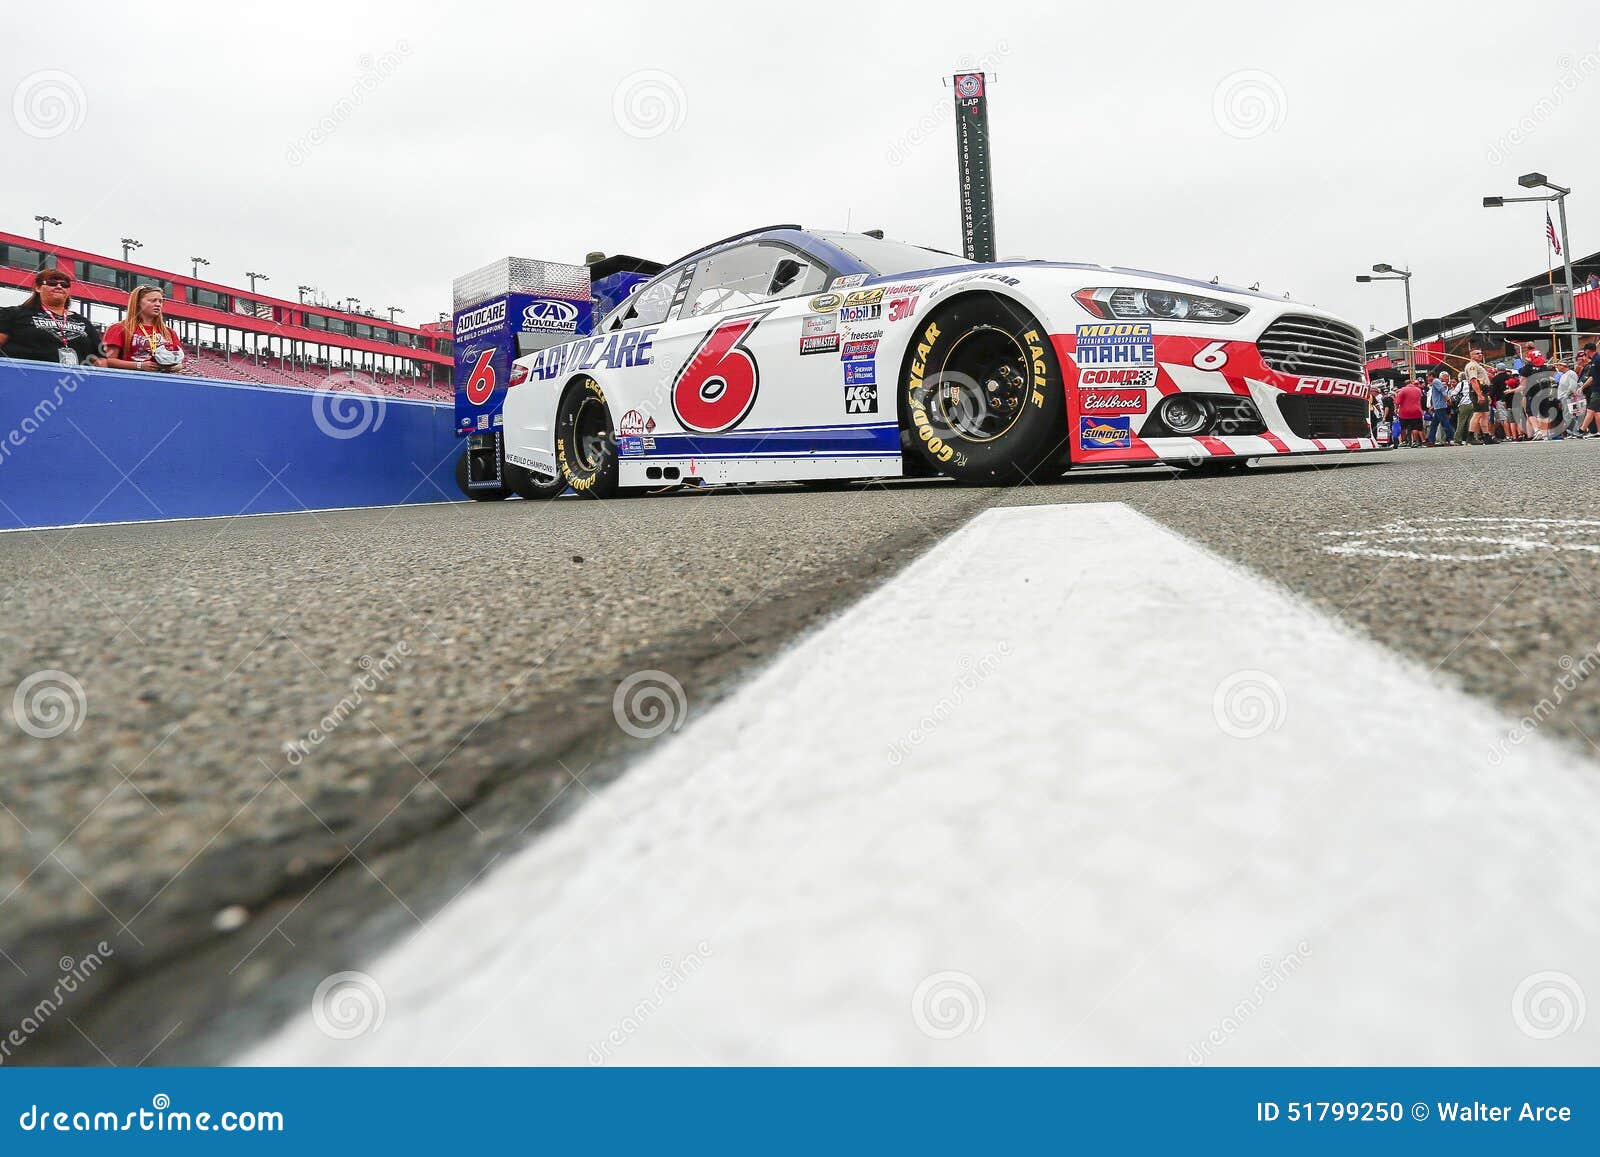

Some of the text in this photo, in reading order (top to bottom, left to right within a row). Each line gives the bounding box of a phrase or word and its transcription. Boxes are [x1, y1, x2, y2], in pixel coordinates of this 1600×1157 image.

[885, 284, 915, 296] Holley
[840, 306, 868, 320] Mobil
[889, 296, 919, 321] 3M
[457, 302, 506, 333] ADVOCARE
[522, 318, 577, 330] ADVOCARE
[851, 329, 883, 340] freescale
[1078, 324, 1149, 337] MOOG
[1114, 336, 1150, 344] SUSPENSION
[530, 329, 659, 382] ADVOCARE
[1077, 346, 1153, 363] MAHLE
[1192, 341, 1230, 372] 6
[467, 348, 496, 405] 6
[671, 306, 780, 434] 6
[1024, 329, 1047, 408] EAGLE
[1082, 370, 1139, 384] COMP
[908, 322, 954, 462] GOODYEAR
[1295, 377, 1369, 398] FUSION
[1085, 395, 1141, 409] Edelbrock
[621, 411, 642, 428] MAG
[1083, 430, 1127, 439] SUNOCO
[506, 453, 553, 473] WE BUILD CHAMPIONS
